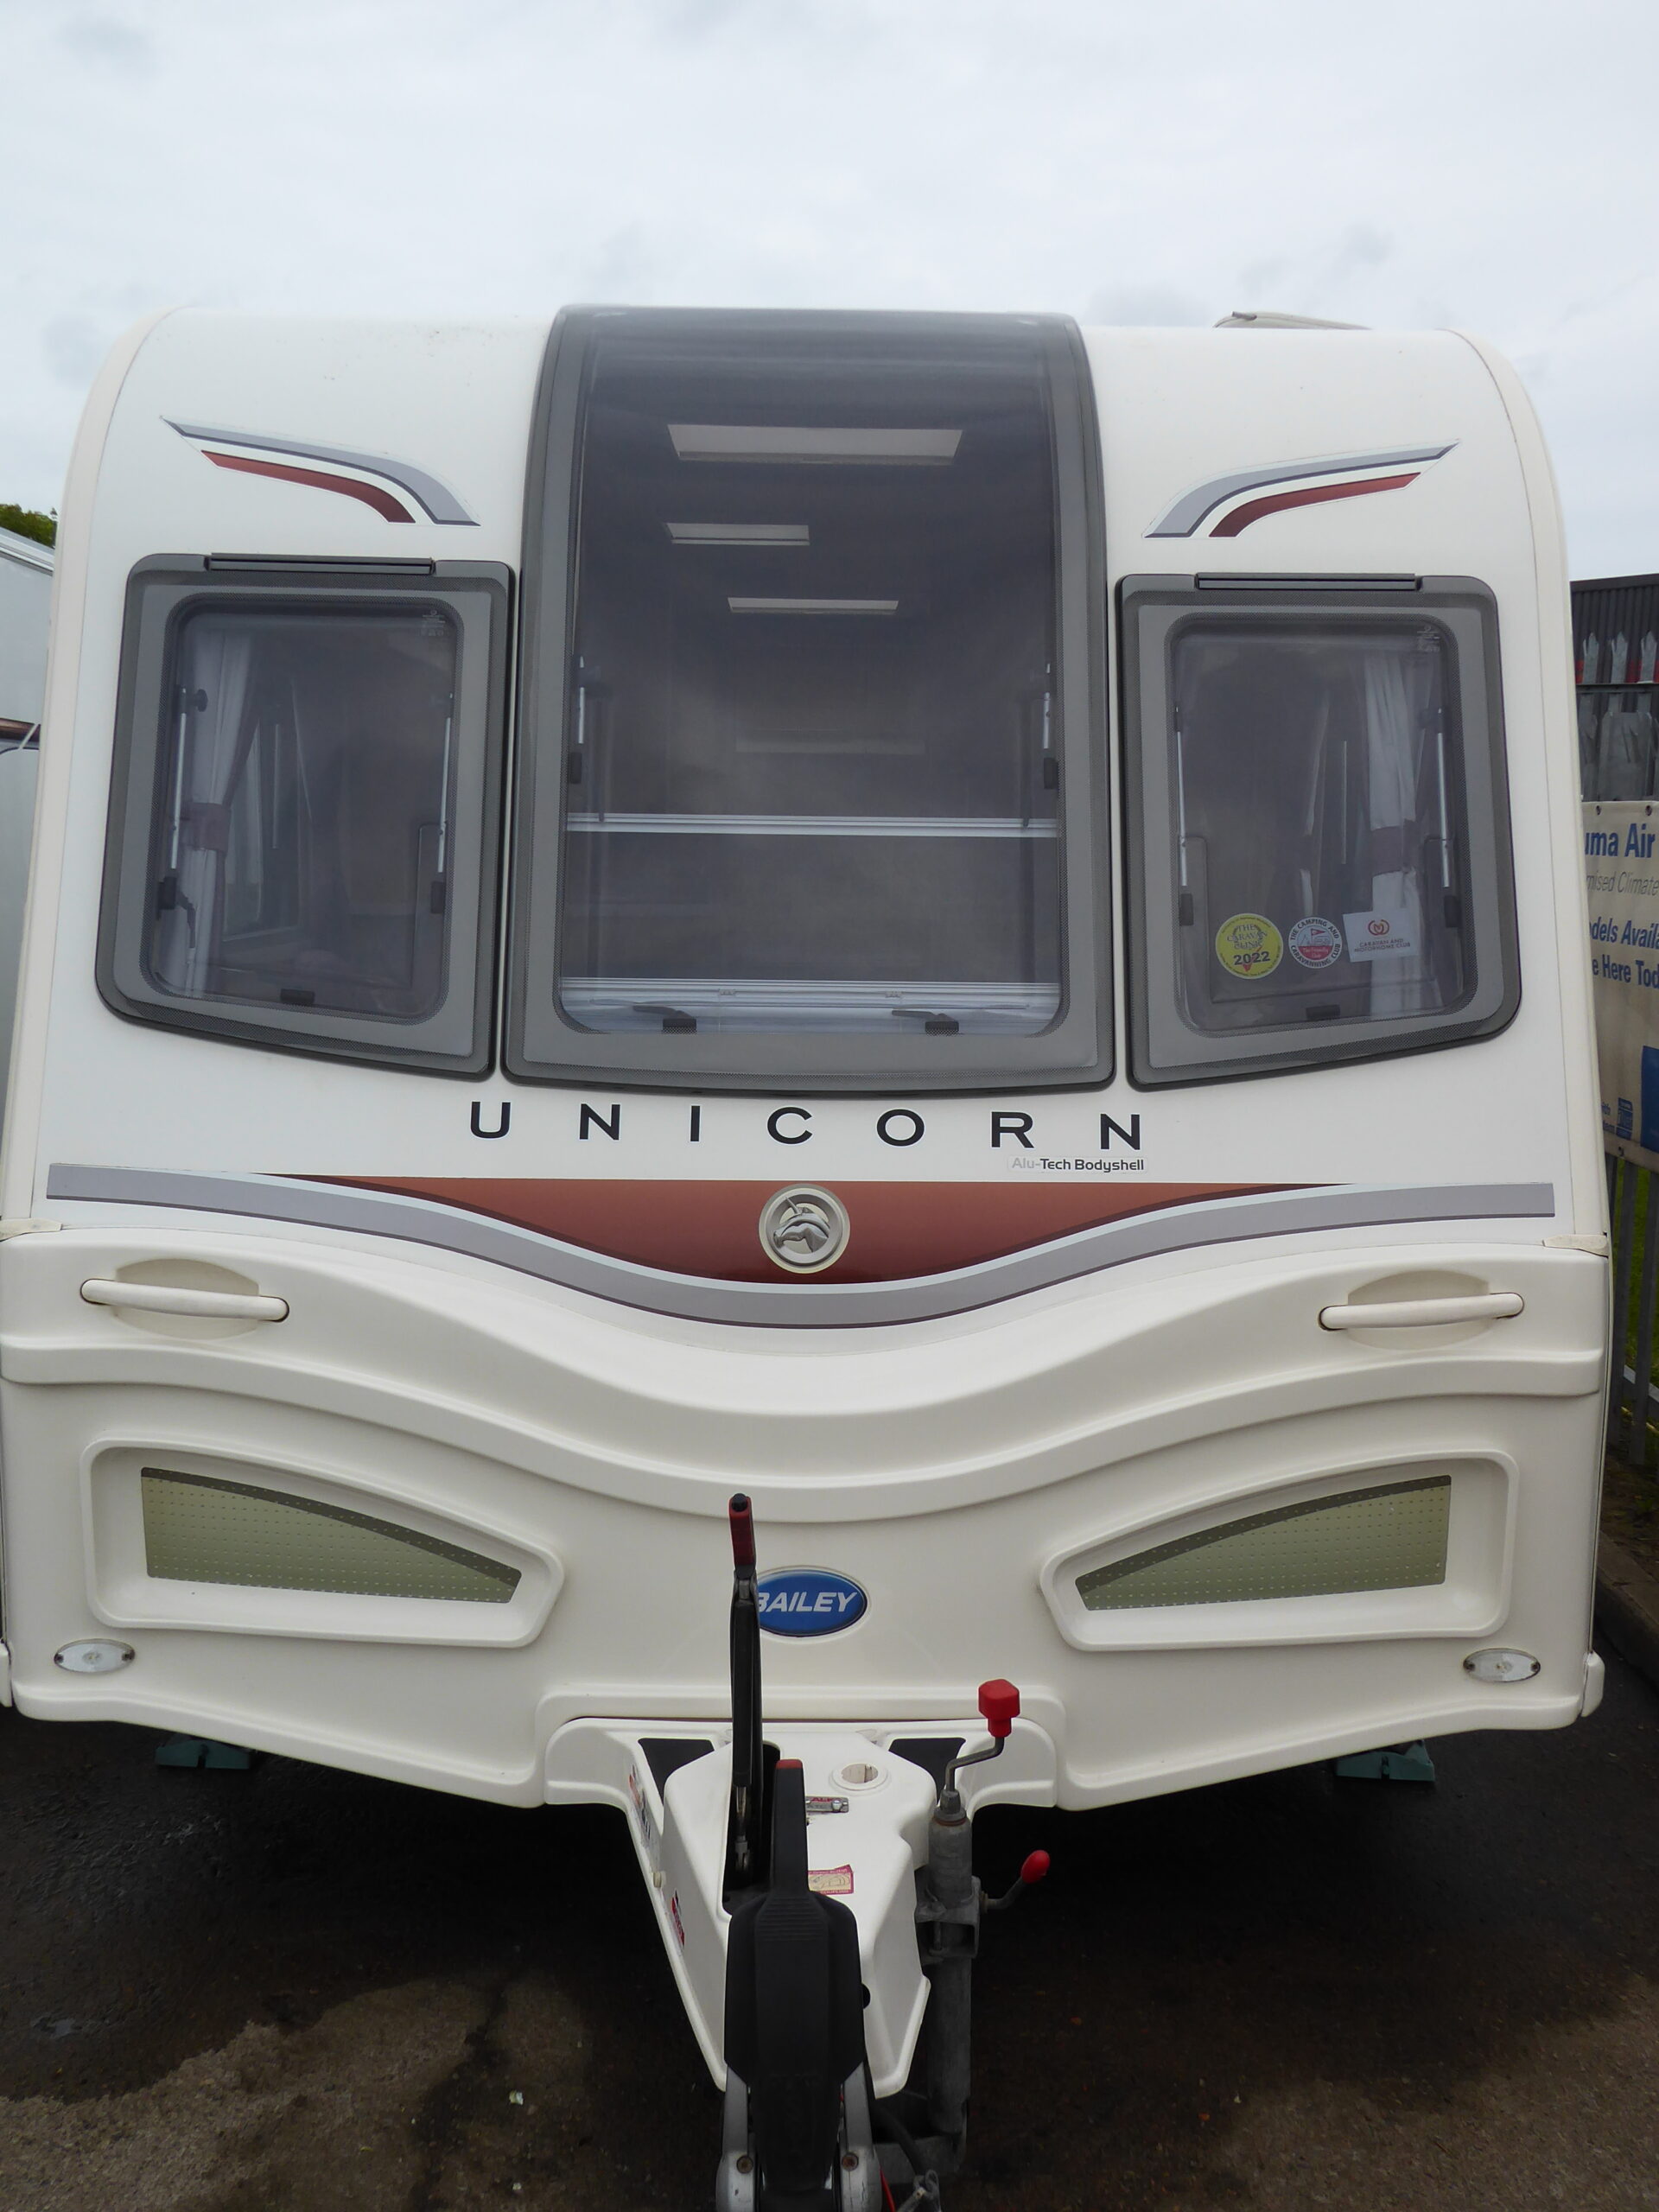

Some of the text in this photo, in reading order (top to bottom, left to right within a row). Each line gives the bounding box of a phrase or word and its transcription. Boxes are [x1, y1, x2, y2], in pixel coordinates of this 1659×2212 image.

[1624, 823, 1656, 858] Air
[1290, 919, 1339, 940] THE CAMPING AND
[1590, 916, 1618, 943] dels
[1233, 951, 1271, 966] 2022
[1291, 945, 1332, 967] CARAVANNING
[1332, 944, 1341, 959] CLUB
[1603, 954, 1631, 983] Here
[471, 1101, 1141, 1151] UNICORN
[1012, 1158, 1144, 1173] Alu-Tech Bodyshell
